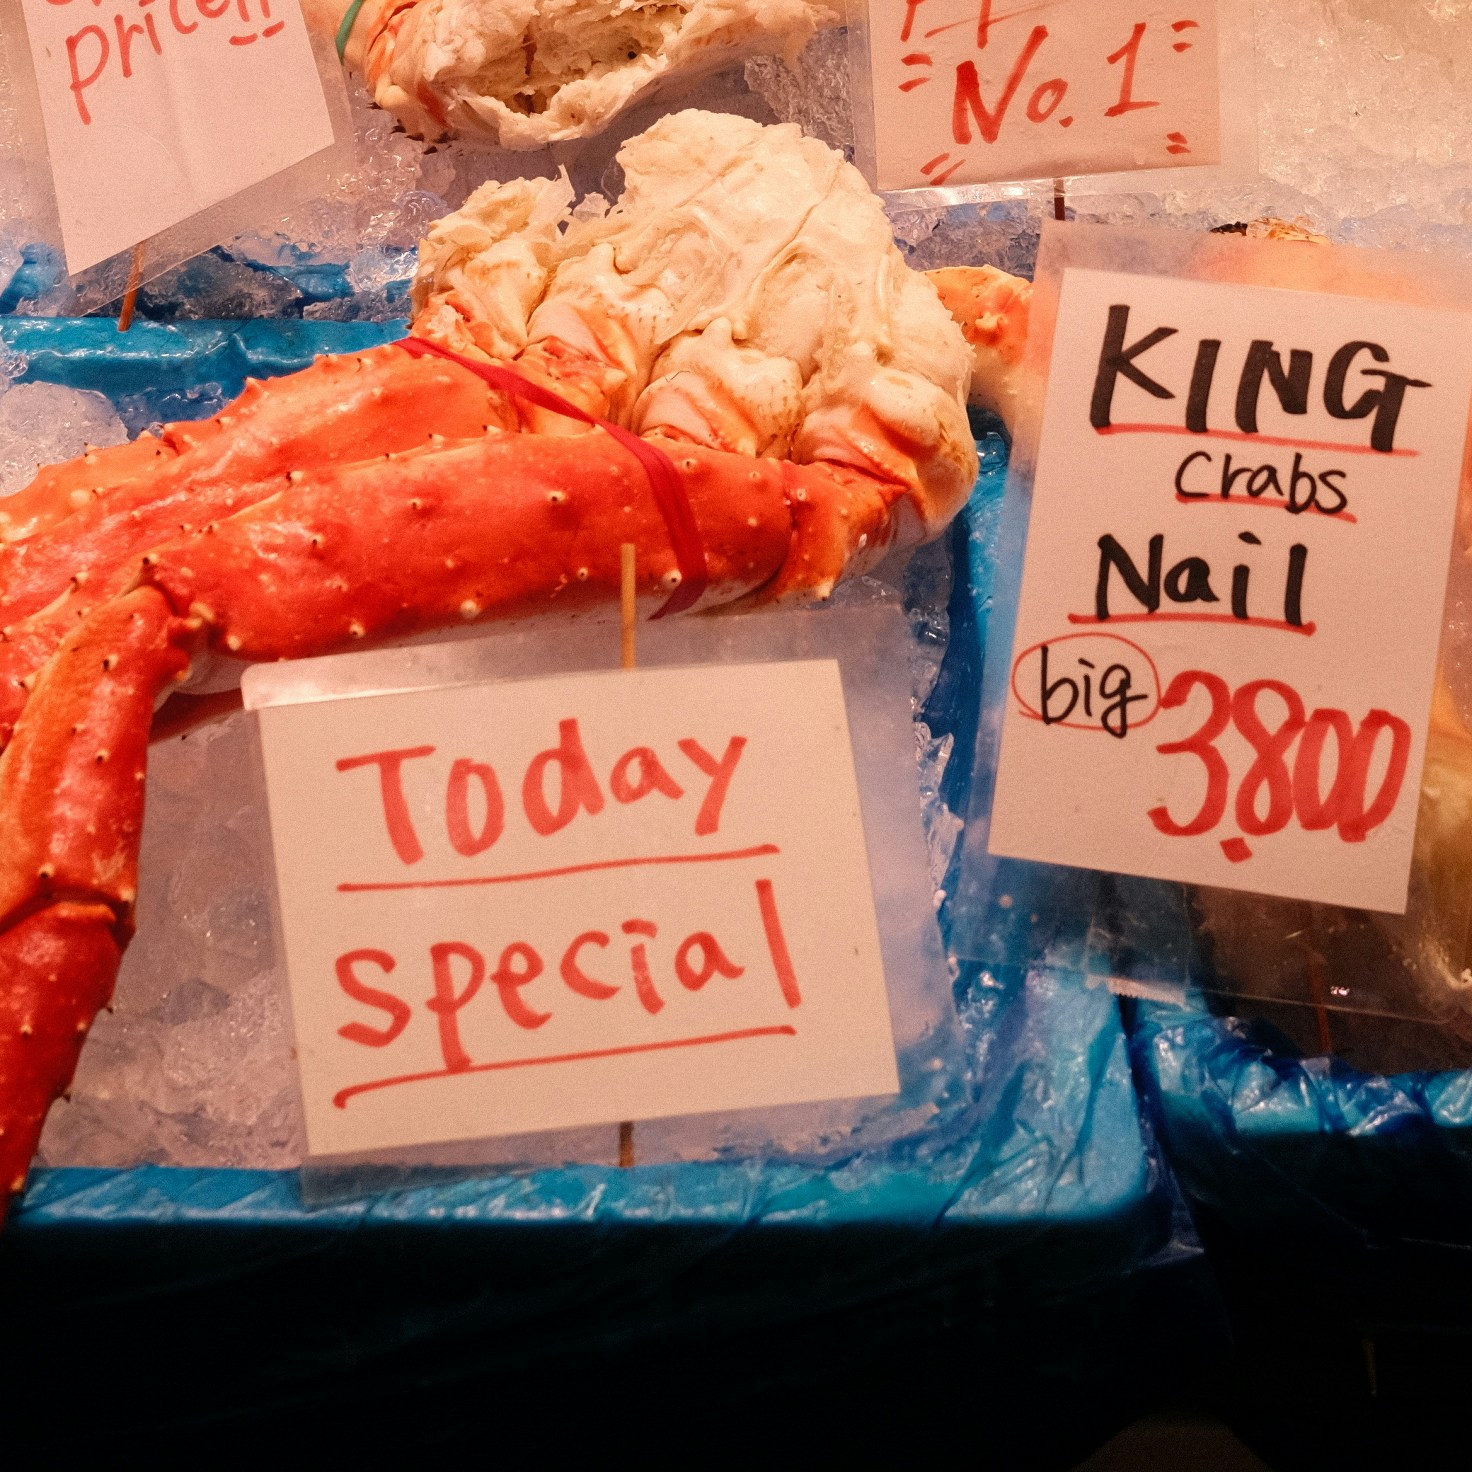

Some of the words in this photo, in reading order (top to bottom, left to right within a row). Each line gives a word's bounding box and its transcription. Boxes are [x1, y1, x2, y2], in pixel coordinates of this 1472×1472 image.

[1088, 303, 1433, 454] KING
[1095, 531, 1309, 627] Nail
[1039, 644, 1147, 737] big
[335, 716, 748, 866] Today
